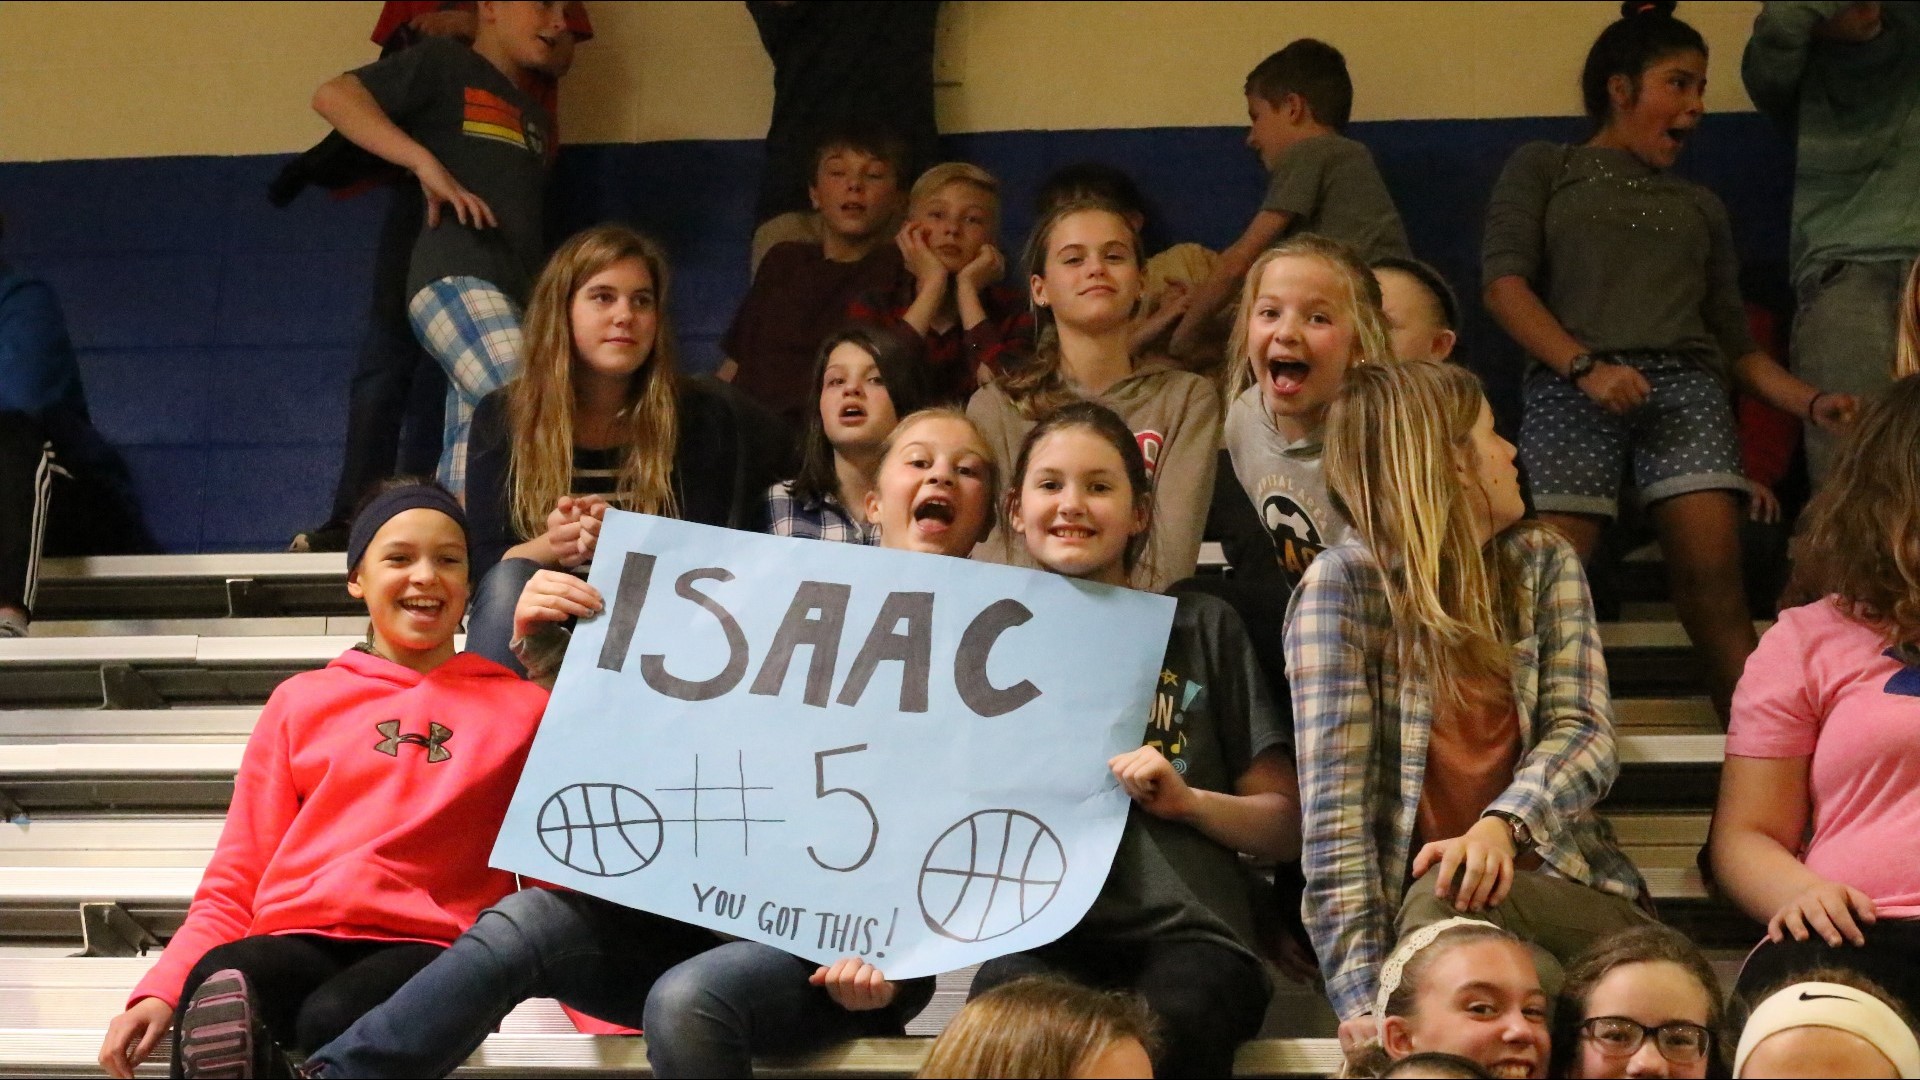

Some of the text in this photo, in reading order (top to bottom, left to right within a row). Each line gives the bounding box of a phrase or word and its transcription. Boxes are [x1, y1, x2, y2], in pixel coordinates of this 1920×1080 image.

[1256, 474, 1294, 502] APITAL
[597, 552, 1043, 718] ISAAC
[692, 883, 899, 959] YOU GOT THIS!
